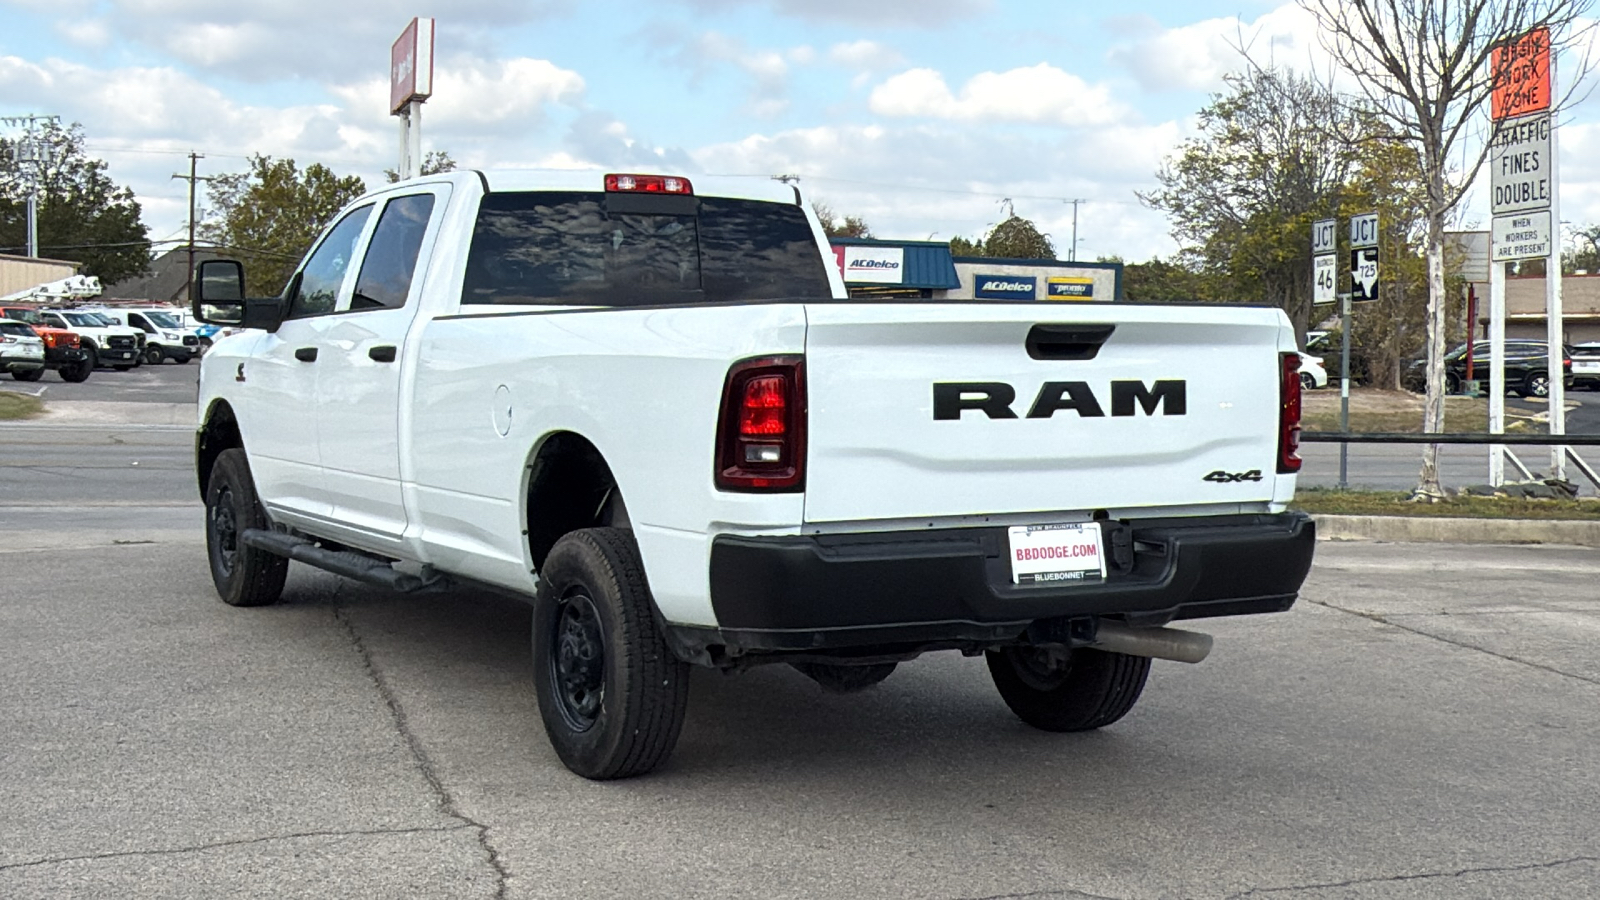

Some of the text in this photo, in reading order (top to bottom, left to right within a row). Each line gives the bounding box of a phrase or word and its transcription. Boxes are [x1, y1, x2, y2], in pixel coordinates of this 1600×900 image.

[1496, 119, 1548, 148] TRAFFIC
[1502, 150, 1540, 176] FINES
[1496, 179, 1547, 205] DOUBLE
[1352, 219, 1377, 242] JCT
[1512, 218, 1531, 228] WHEN
[1315, 225, 1334, 248] JCT
[1505, 230, 1538, 242] WORKERS
[1498, 243, 1546, 257] ARE PRESENT
[849, 259, 899, 269] ACDelco
[1360, 264, 1376, 278] 725
[981, 281, 1033, 292] ACDelco
[1317, 270, 1333, 290] 46
[933, 380, 1187, 420] RAM
[1202, 469, 1263, 483] 4x4
[1016, 544, 1096, 561] BBDODGE.COM
[1034, 571, 1085, 582] BLUEBONNET
